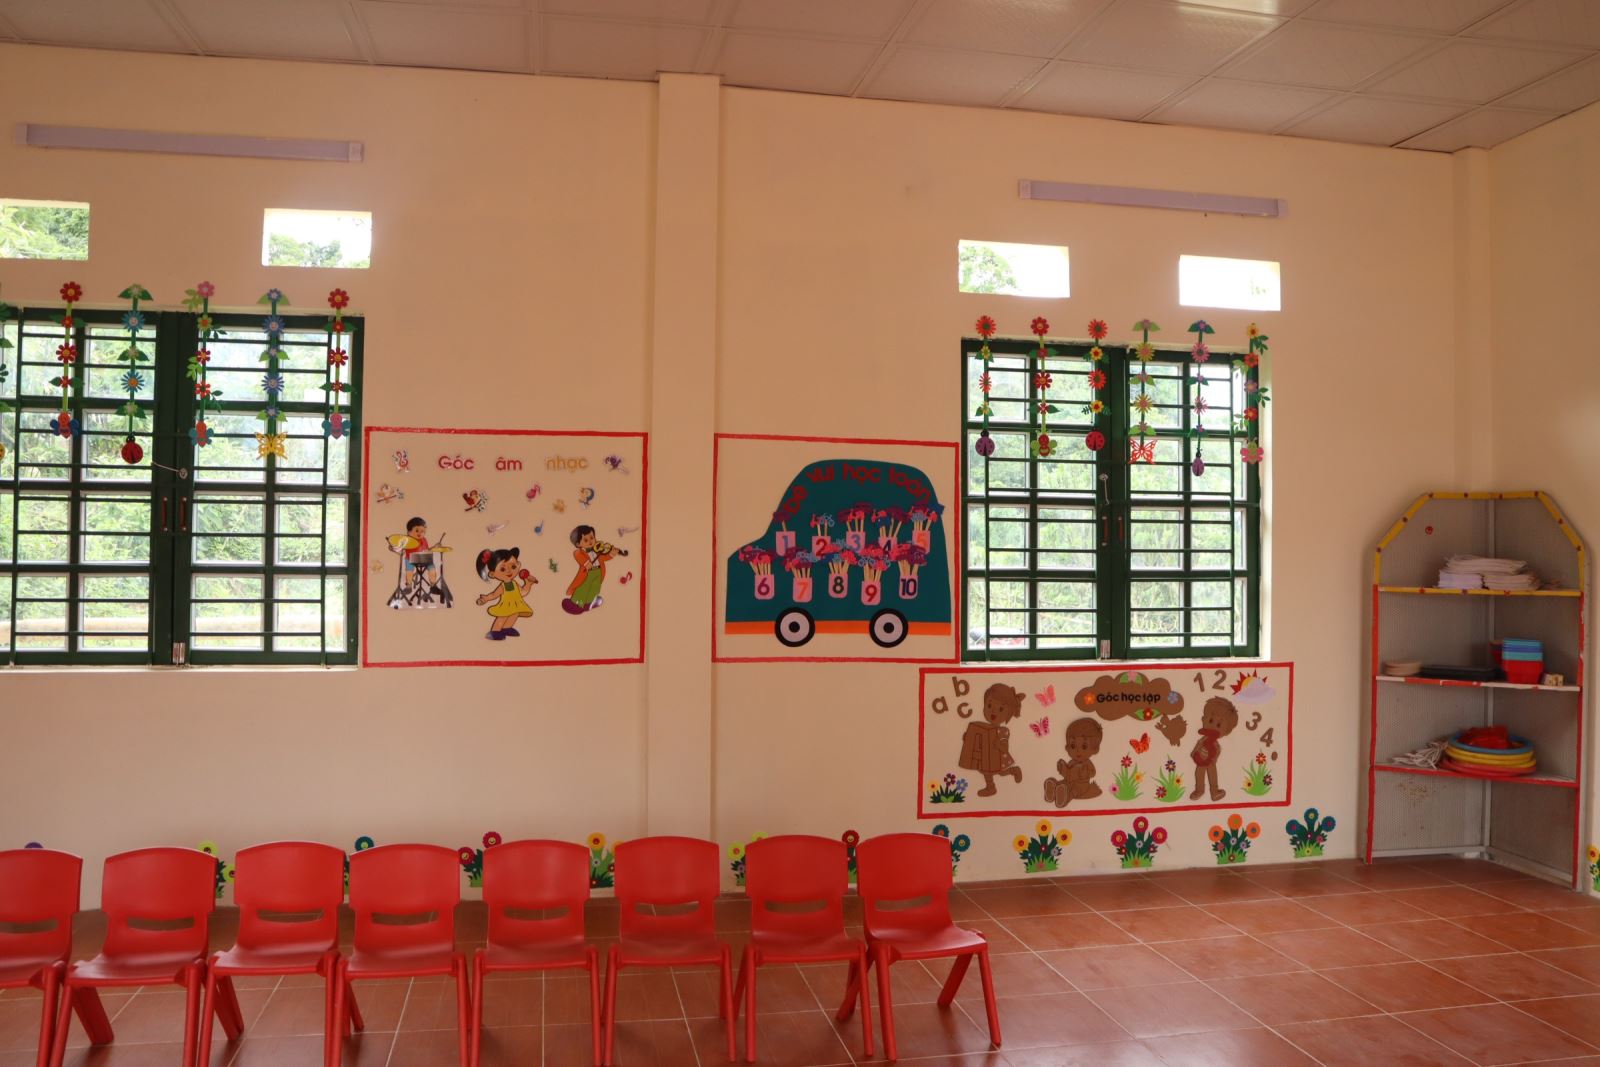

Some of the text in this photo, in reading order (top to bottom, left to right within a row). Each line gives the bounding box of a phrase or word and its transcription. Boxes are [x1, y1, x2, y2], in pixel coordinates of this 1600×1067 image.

[438, 454, 589, 473] Góc âm nhạc
[842, 462, 881, 485] học
[782, 535, 789, 549] 1
[816, 538, 829, 556] 2
[851, 534, 861, 552] 3
[883, 539, 892, 557] 4
[917, 532, 928, 550] 5
[757, 577, 770, 596] 6
[798, 581, 809, 599] 7
[832, 576, 845, 594] 8
[865, 584, 878, 602] 9
[900, 578, 917, 596] 10
[952, 676, 970, 697] b
[1193, 669, 1227, 692] 1 2
[932, 696, 949, 714] a
[1096, 691, 1119, 703] Góc
[1121, 691, 1141, 704] học
[957, 702, 973, 719] c
[1246, 711, 1262, 731] 3
[1260, 727, 1274, 747] 4
